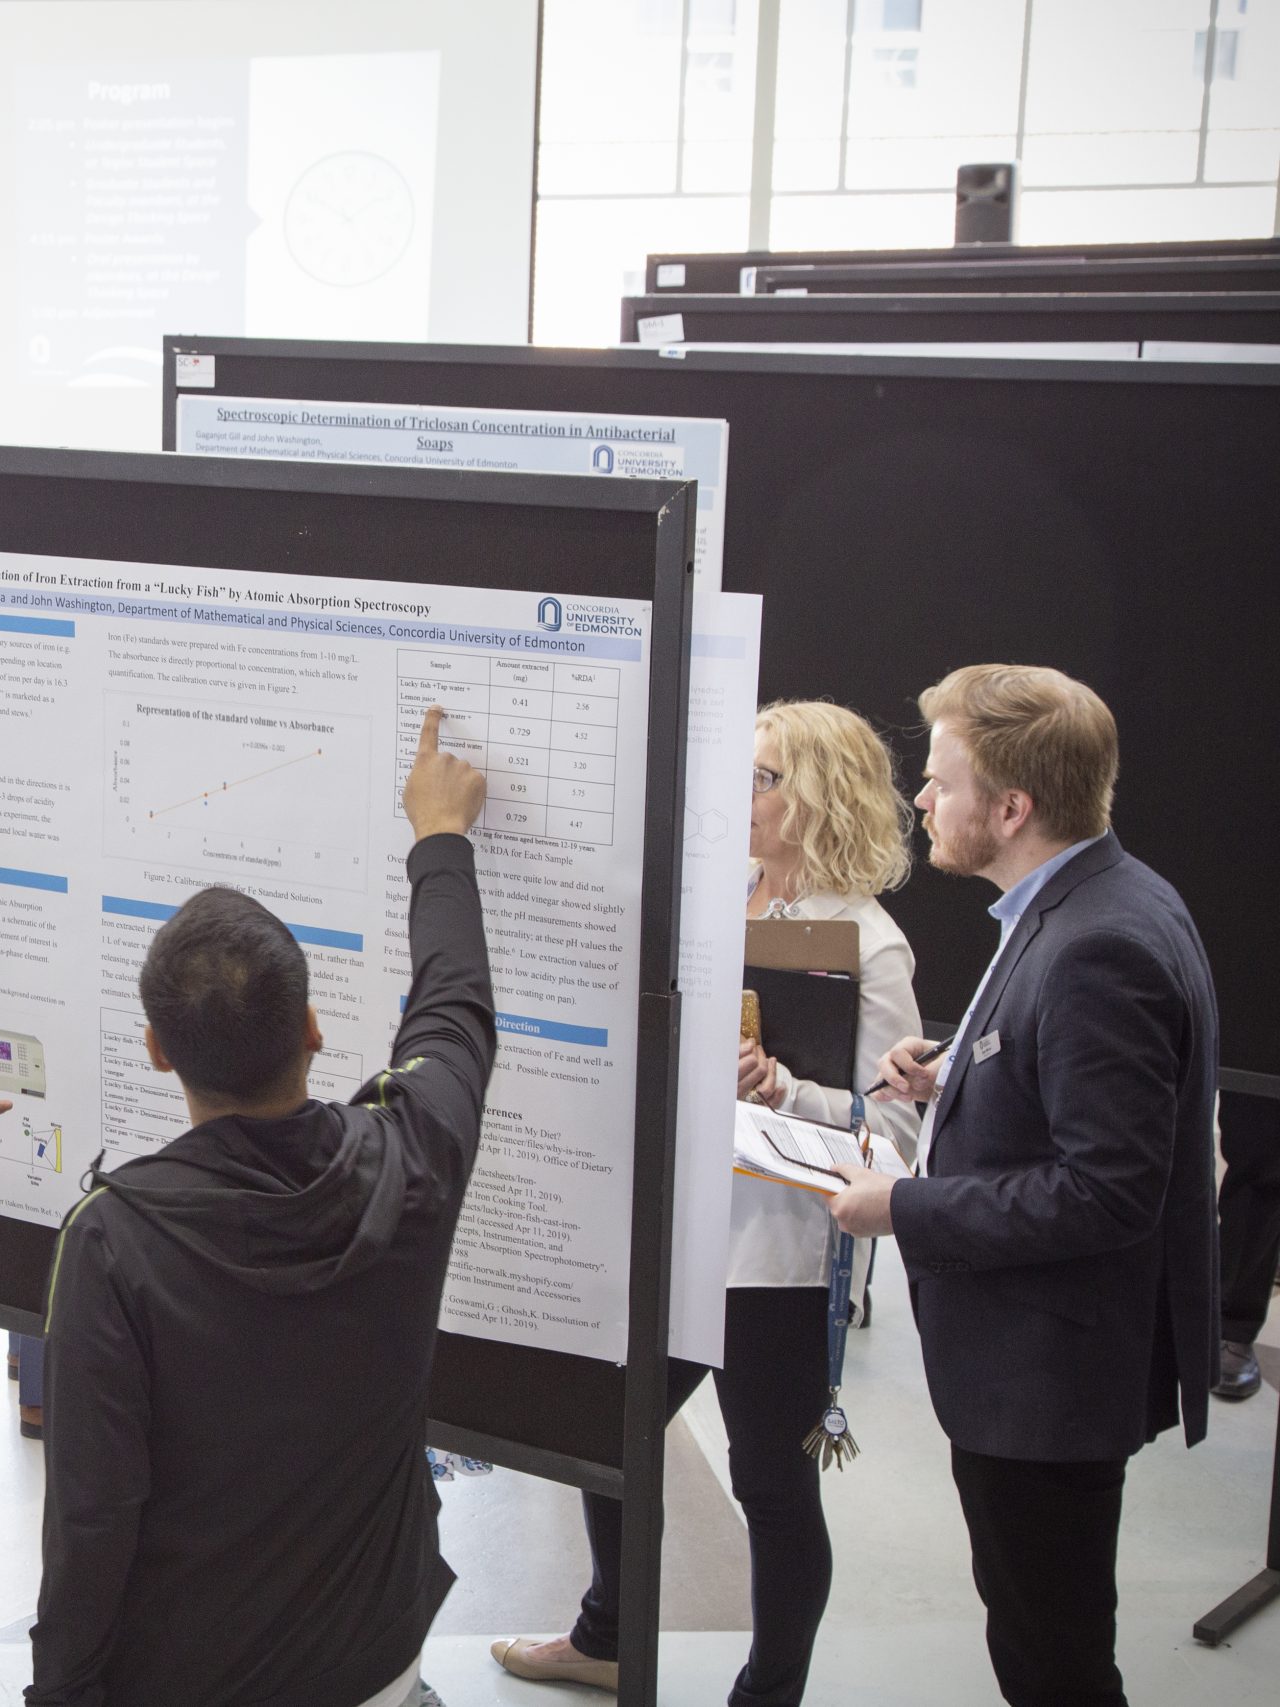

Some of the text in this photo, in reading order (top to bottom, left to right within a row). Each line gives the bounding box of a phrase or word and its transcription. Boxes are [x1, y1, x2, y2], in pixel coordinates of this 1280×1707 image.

[88, 80, 170, 106] Program
[178, 357, 200, 367] SC-
[217, 408, 675, 441] Spectroscopic Determination of Triclosan Concentration in Antibacterial
[228, 432, 241, 440] Gill
[242, 433, 256, 441] and
[256, 434, 275, 442] John
[416, 437, 454, 451] Soaps
[195, 443, 238, 453] Department
[239, 445, 248, 454] of
[248, 446, 300, 456] Mathematical
[316, 449, 347, 459] Physical
[384, 453, 424, 463] Concordia
[425, 456, 465, 466] University
[466, 457, 475, 466] of
[476, 458, 518, 468] Edmonton
[617, 458, 676, 468] UNIVERSITY
[624, 466, 683, 476] EDMONTON
[22, 571, 34, 582] of
[35, 572, 57, 584] Iron
[60, 574, 113, 588] Extraction
[116, 578, 141, 591] from
[144, 584, 151, 592] a
[228, 587, 241, 602] by
[244, 590, 284, 602] Atomic
[287, 593, 350, 609] Absorption
[354, 598, 432, 617] Spectroscopy
[566, 604, 620, 614] CONCORDIA
[10, 593, 28, 604] and
[30, 594, 53, 606] John
[117, 602, 178, 617] Department
[180, 607, 192, 618] of
[194, 609, 265, 624] Mathematical
[267, 616, 288, 627] and
[290, 616, 333, 630] Physical
[388, 624, 446, 639] Concordia
[449, 629, 506, 647] University
[508, 634, 522, 646] of
[524, 635, 585, 651] Edmonton
[566, 613, 634, 625] UNIVERSITY
[575, 624, 642, 636] EDMONTON
[430, 660, 452, 670] Sample
[496, 660, 520, 668] Amount
[512, 674, 528, 682] (mg)
[400, 692, 421, 701] Lemon
[511, 697, 528, 706] 0.41
[575, 702, 590, 710] 2.56
[136, 703, 335, 733] Representation of the standard volume vs Absorbance
[509, 727, 531, 736] 0.729
[574, 732, 588, 740] 4.52
[507, 756, 587, 769] 0.521 3.20
[510, 783, 527, 792] 0.93
[505, 812, 528, 822] 0.729
[489, 845, 509, 856] RDA
[511, 848, 522, 858] for
[524, 850, 543, 860] Each
[544, 853, 573, 865] Sample
[502, 872, 522, 881] were
[522, 874, 542, 884] quite
[543, 876, 558, 886] low
[559, 880, 575, 888] and
[575, 881, 589, 891] did
[488, 888, 626, 915] with added vinegar showed slightly
[482, 1104, 523, 1120] ferences
[478, 1241, 522, 1256] Absorption
[473, 1275, 581, 1302] Instrument and Accessories
